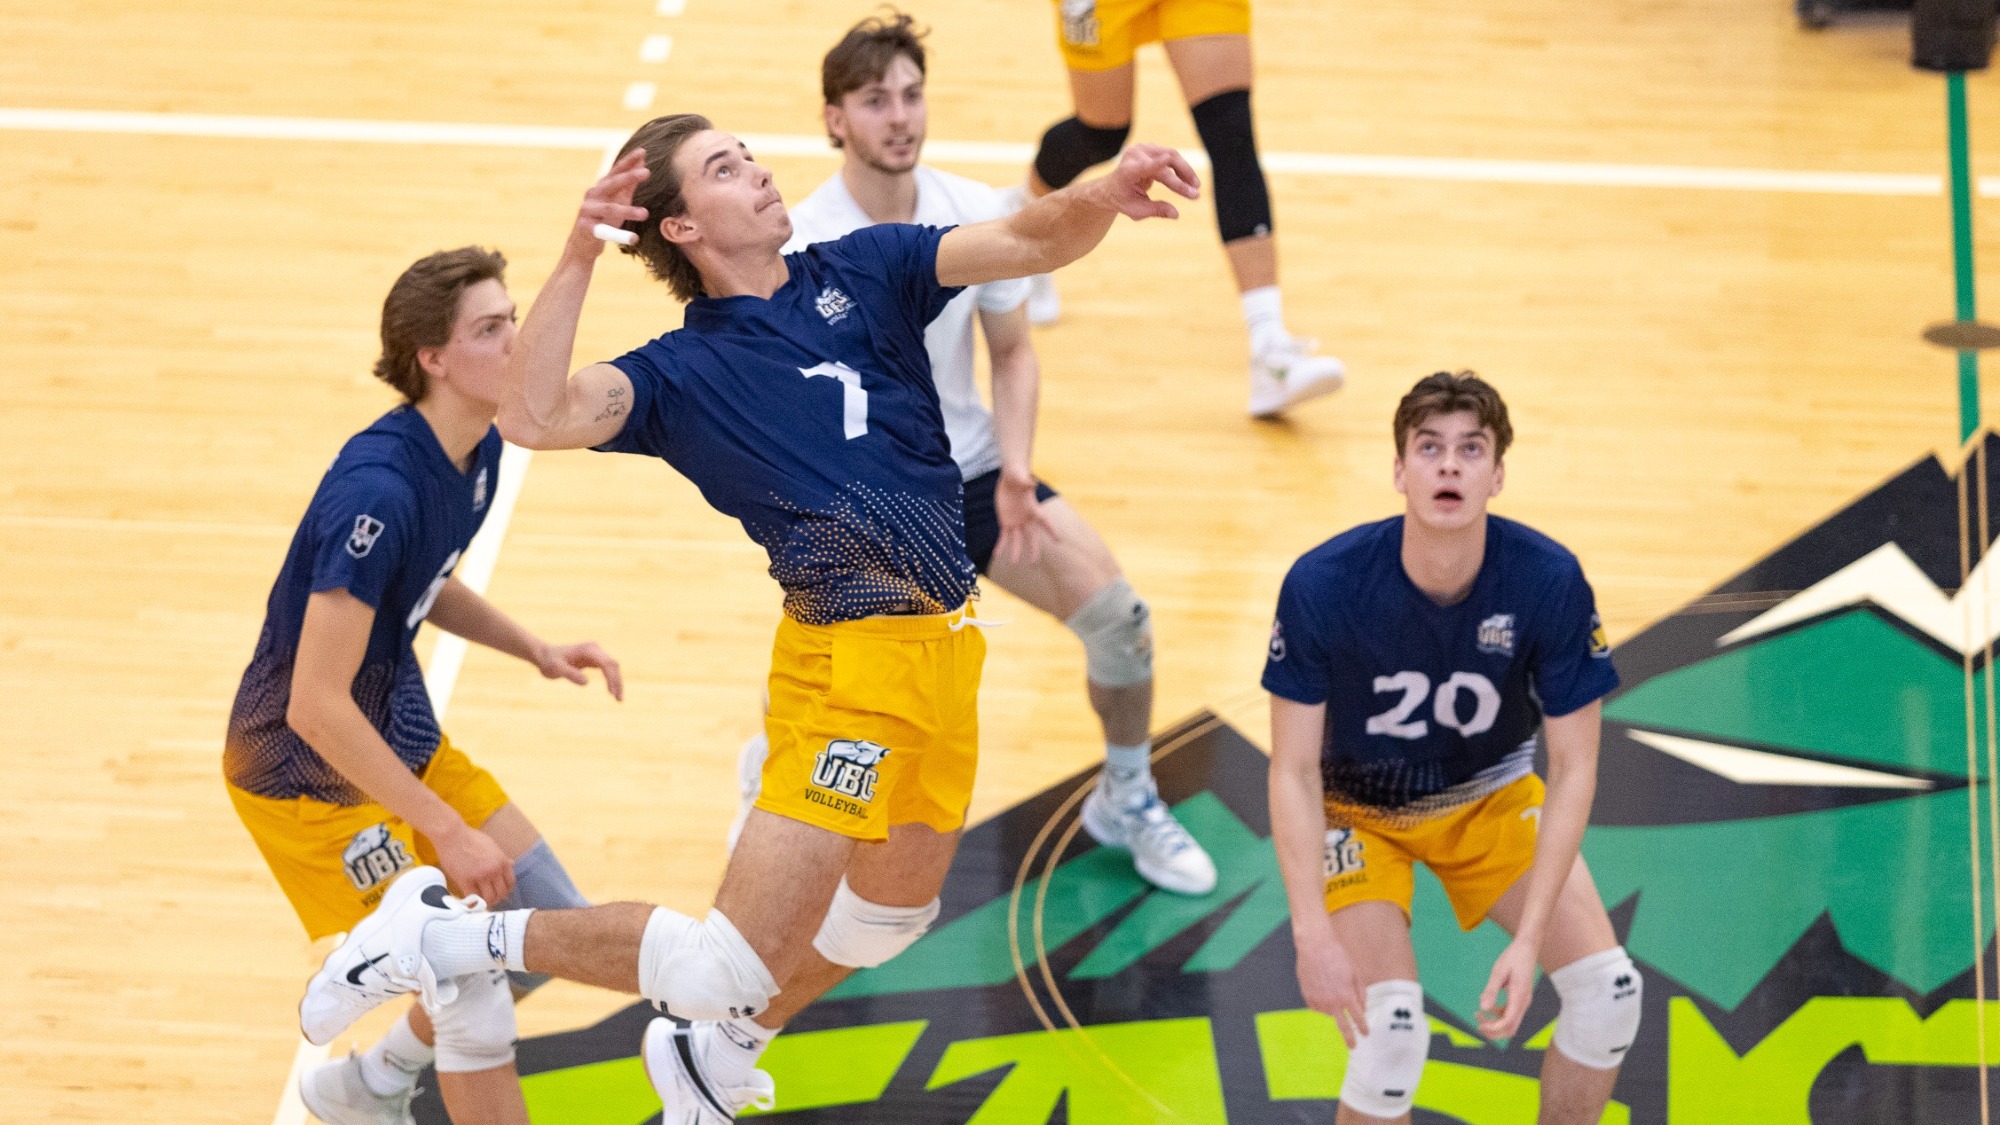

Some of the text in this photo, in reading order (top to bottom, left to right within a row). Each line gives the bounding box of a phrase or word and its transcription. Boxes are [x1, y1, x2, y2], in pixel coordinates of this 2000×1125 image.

[1366, 670, 1501, 740] 20
[812, 752, 878, 803] UBC
[804, 788, 868, 819] VOLLEYBAL
[343, 838, 414, 892] UBC
[1323, 842, 1366, 877] BC
